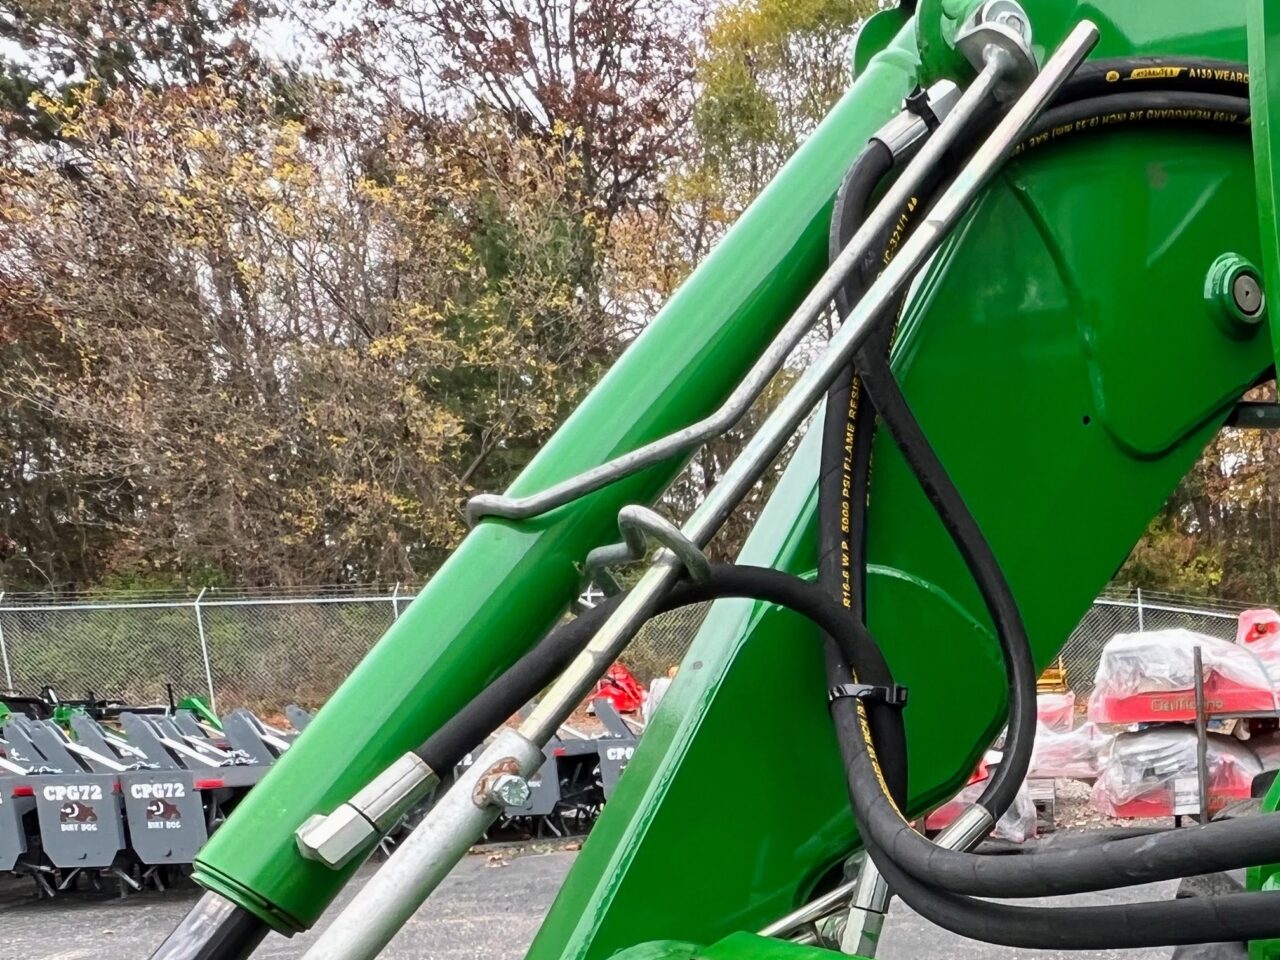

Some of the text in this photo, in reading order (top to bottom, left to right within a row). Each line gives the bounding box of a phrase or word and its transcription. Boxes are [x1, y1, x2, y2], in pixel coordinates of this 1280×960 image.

[1214, 69, 1249, 84] WEARG
[843, 422, 856, 471] FLAME
[842, 474, 851, 498] PSI
[841, 501, 850, 533] 5000
[606, 746, 635, 761] CPG
[43, 784, 103, 801] CPG72
[131, 782, 185, 799] CPG72
